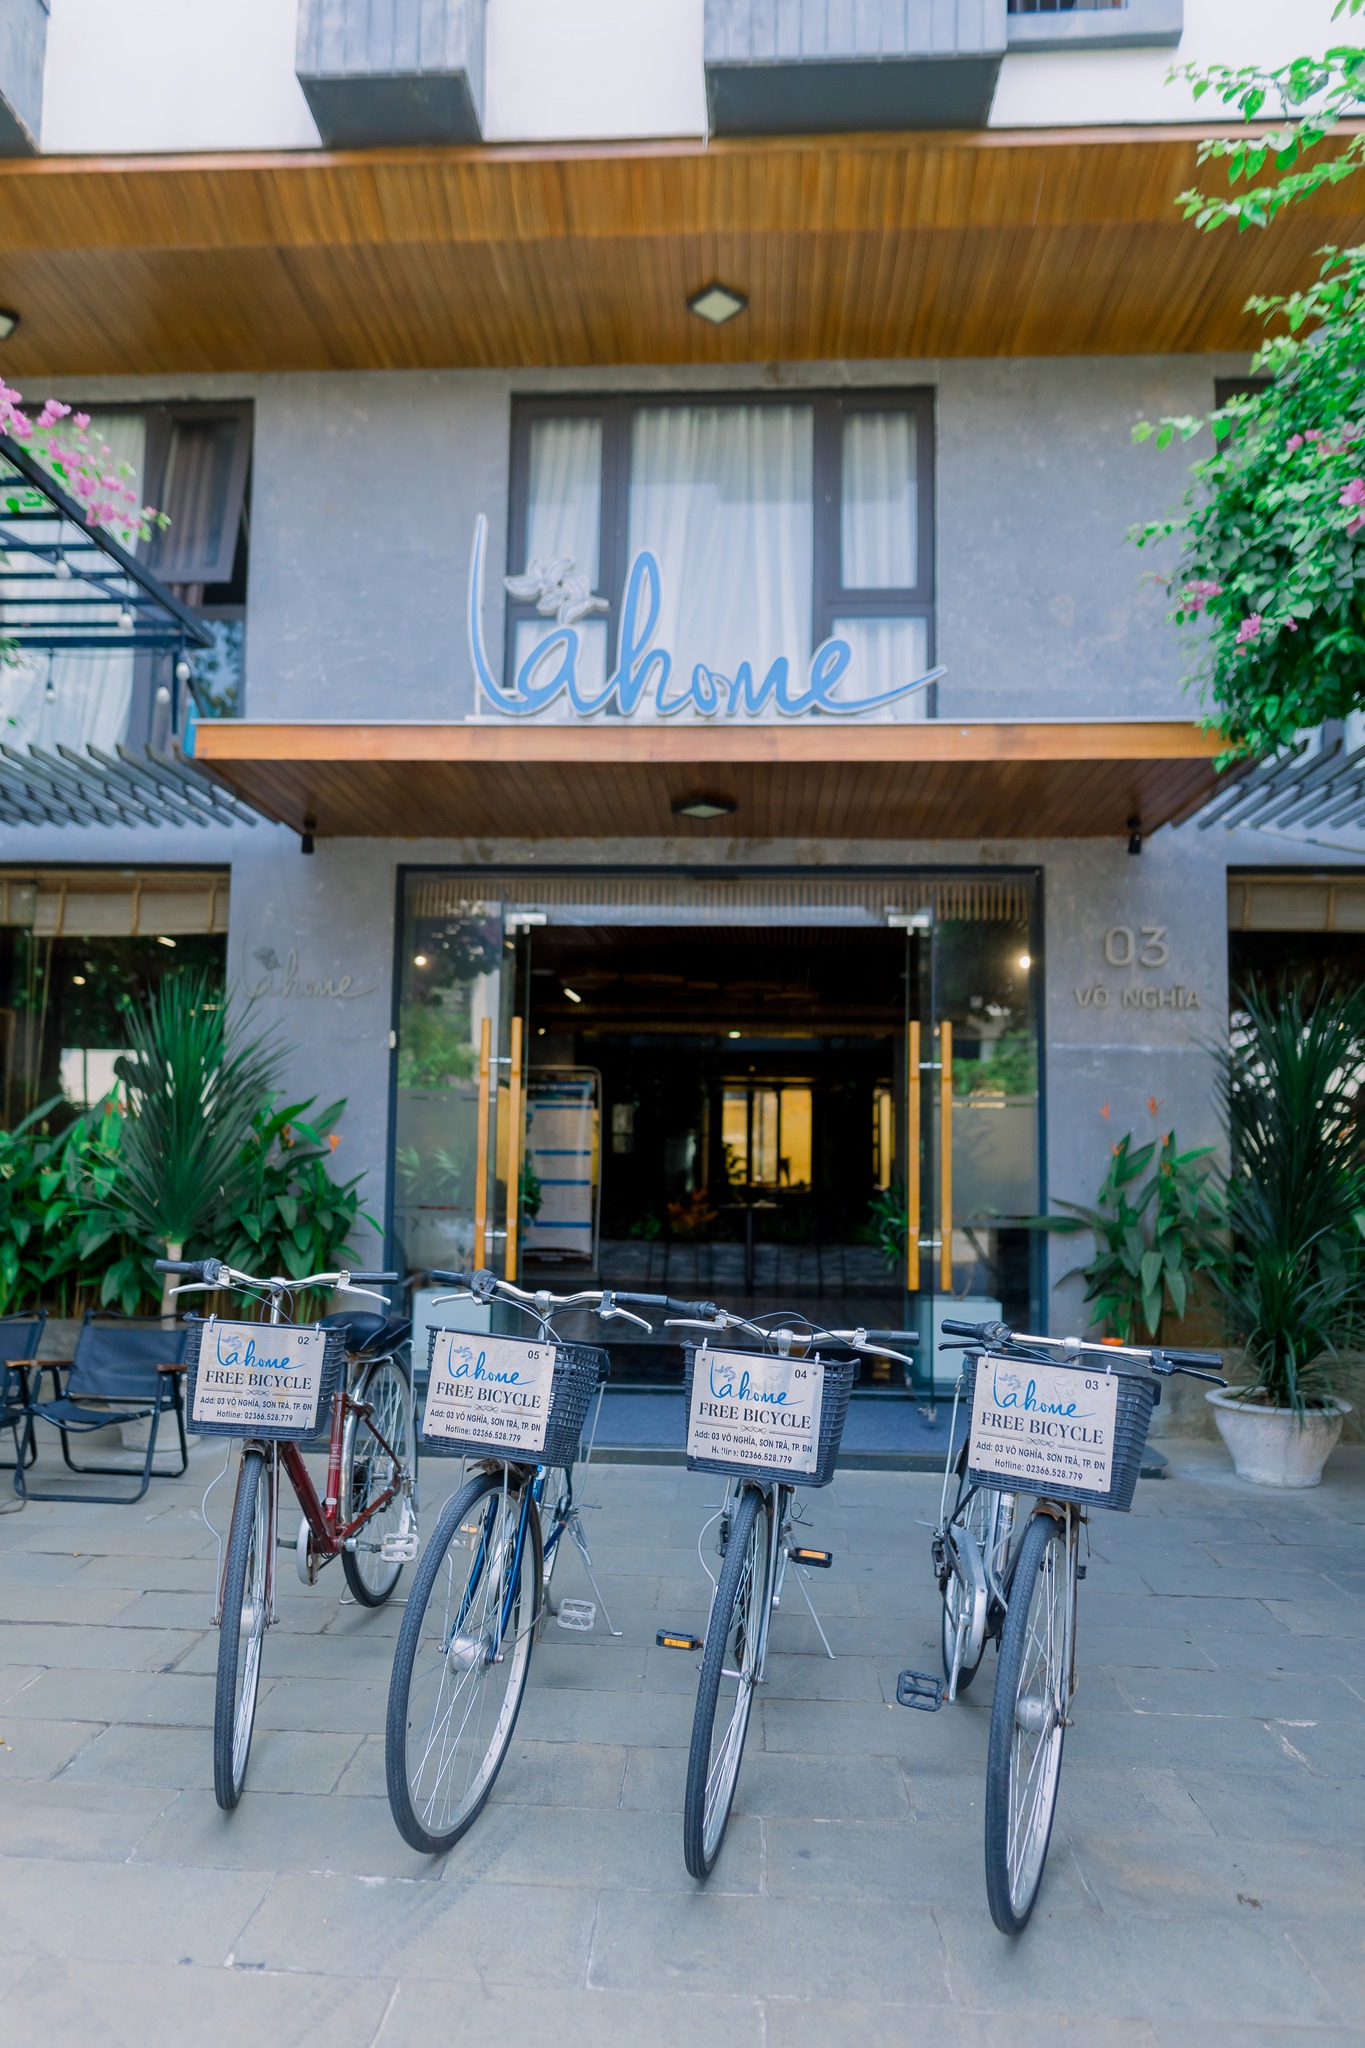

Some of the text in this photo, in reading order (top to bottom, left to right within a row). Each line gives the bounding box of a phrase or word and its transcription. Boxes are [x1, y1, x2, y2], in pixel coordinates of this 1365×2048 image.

[1104, 925, 1169, 968] 03
[298, 1336, 309, 1345] 02
[528, 1350, 539, 1360] 05
[205, 1371, 311, 1389] FREE BICYCLE
[795, 1369, 807, 1379] 04
[1085, 1380, 1098, 1390] 03
[200, 1396, 215, 1405] Add:
[436, 1382, 541, 1408] FREE BICYCLE
[217, 1410, 293, 1422] Hotline: 02366.528.779
[430, 1409, 445, 1418] Add:
[531, 1423, 541, 1432] ĐN
[699, 1402, 811, 1429] FREE BICYCLE
[445, 1424, 521, 1442] Hotline: 02366.528.779
[981, 1412, 1104, 1444] FREE BICYCLE
[694, 1430, 710, 1439] Add:
[711, 1432, 720, 1440] 03
[802, 1445, 812, 1453] ĐN
[740, 1450, 792, 1464] 02366.528.779
[976, 1441, 993, 1451] Add:
[995, 1444, 1003, 1453] 03
[1094, 1462, 1105, 1470] ĐN
[994, 1459, 1083, 1481] Hotline: 02366.528.779
